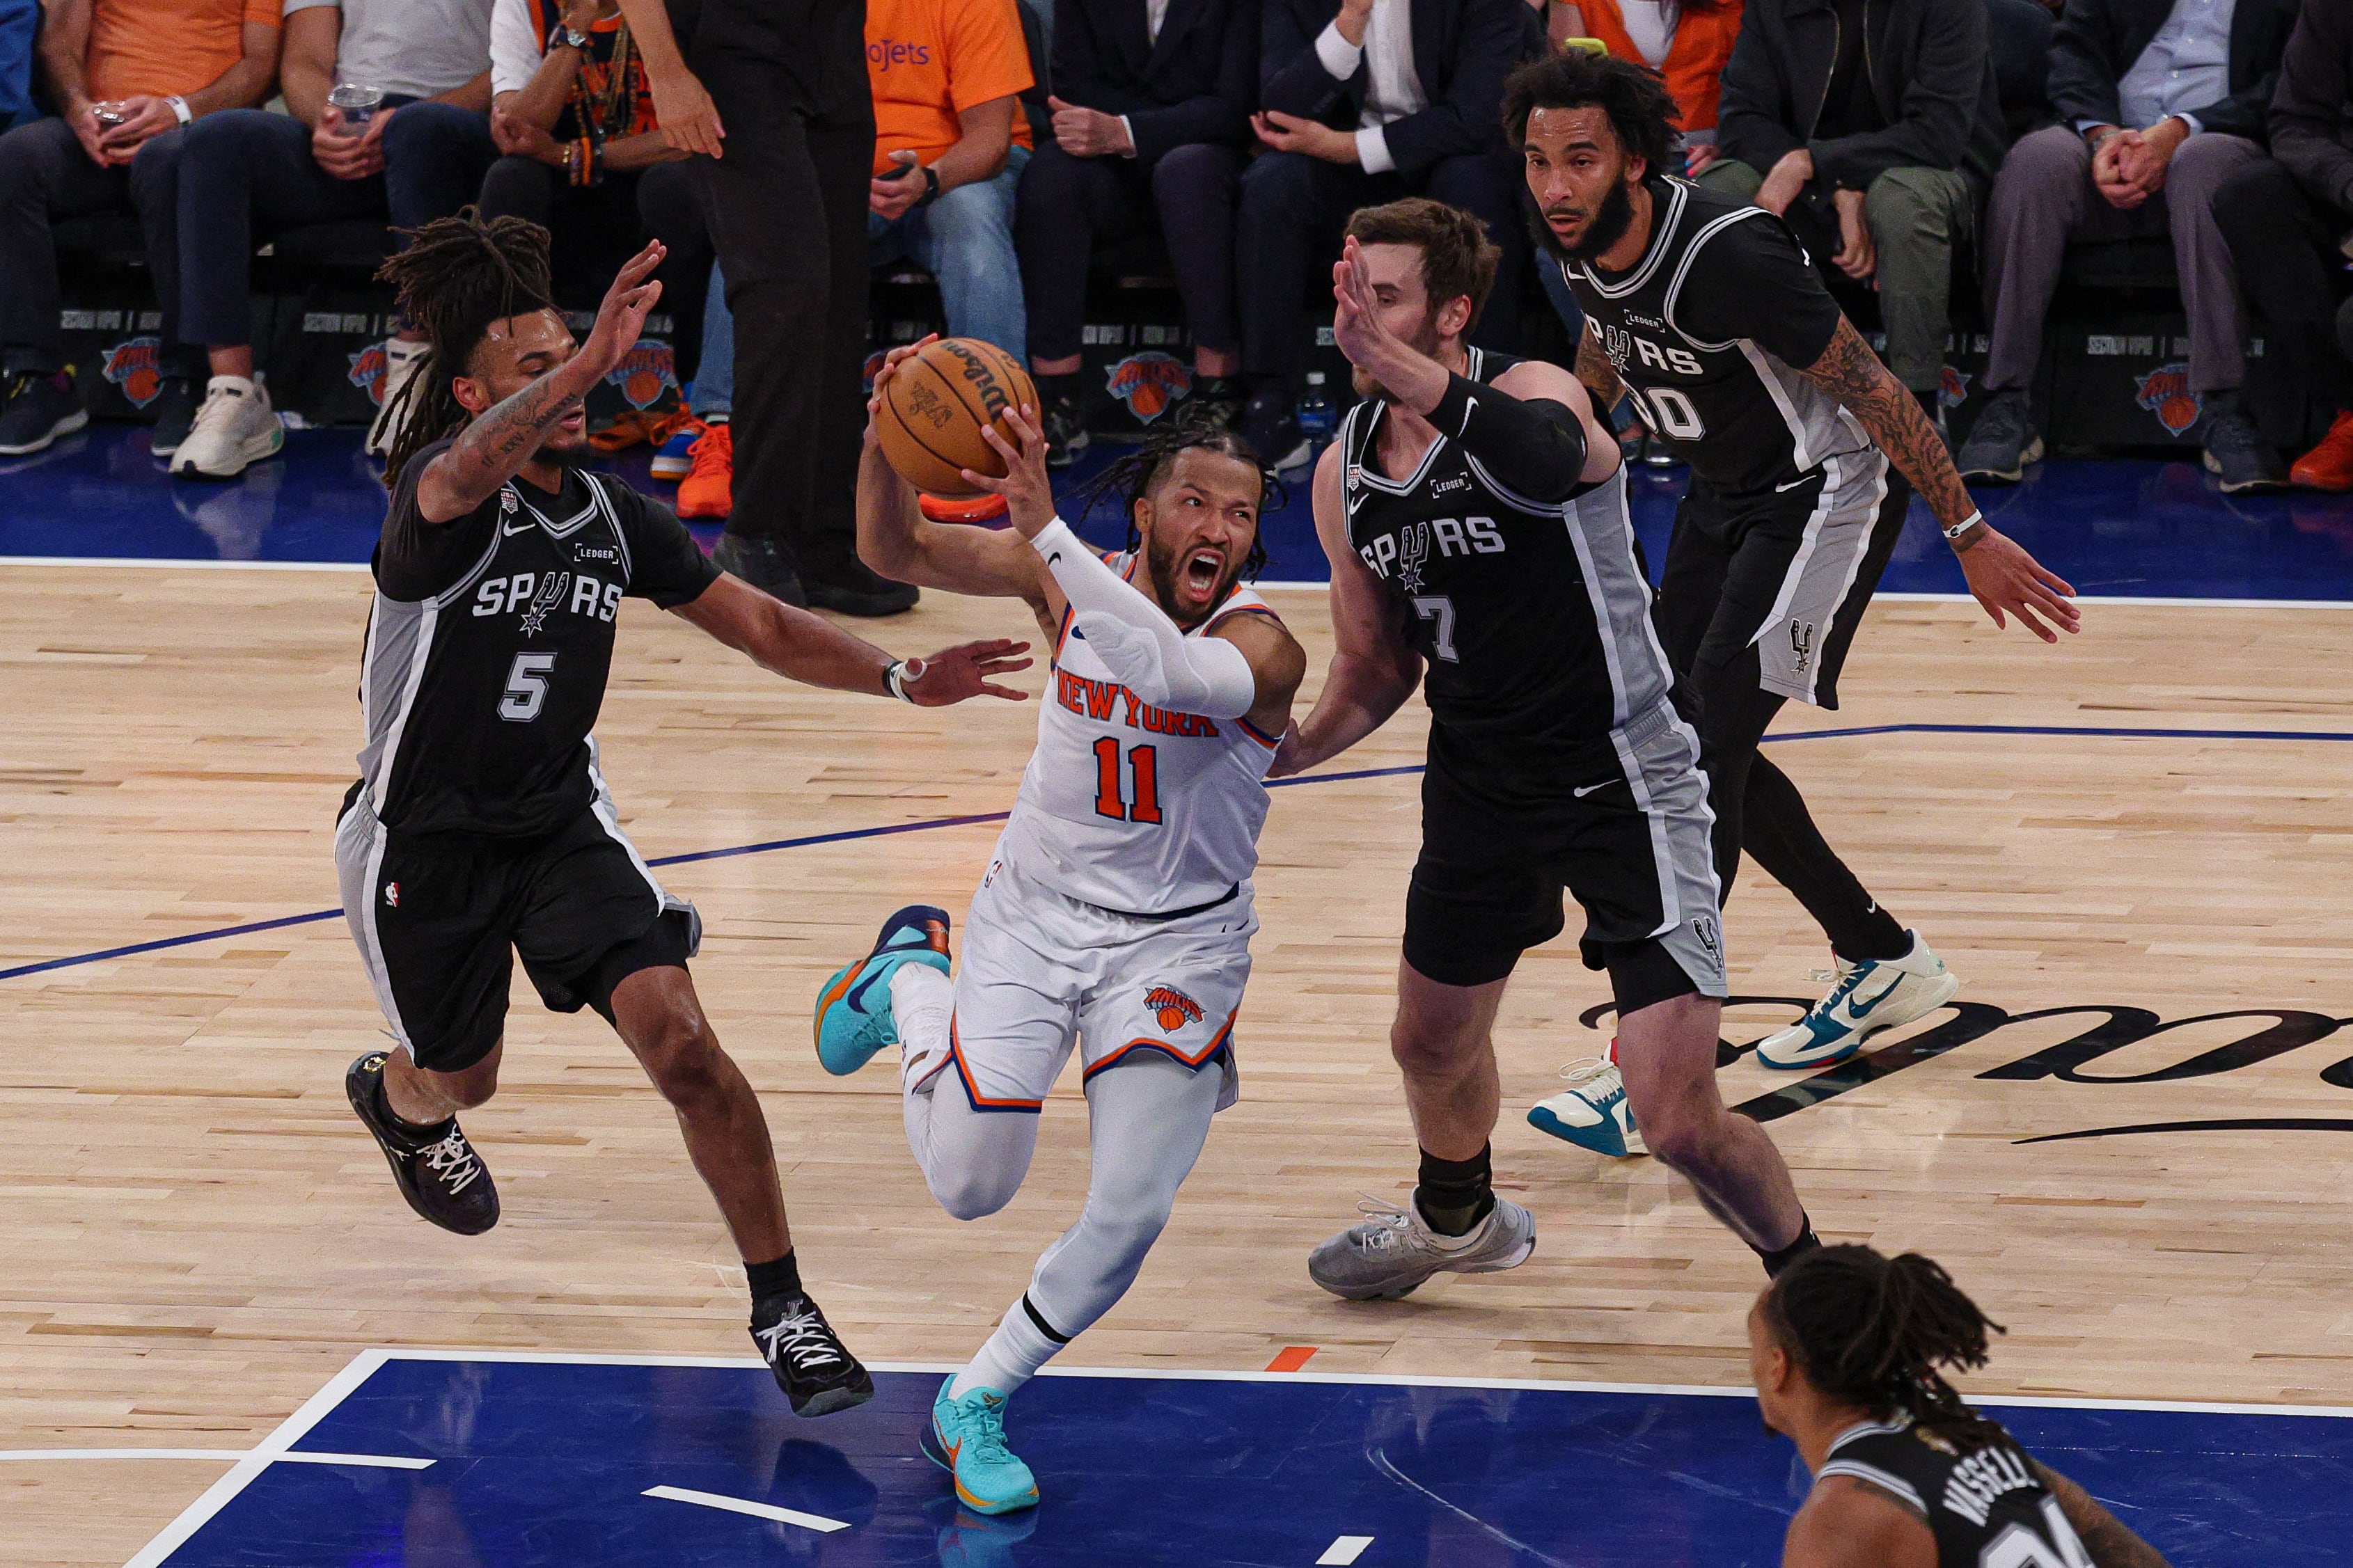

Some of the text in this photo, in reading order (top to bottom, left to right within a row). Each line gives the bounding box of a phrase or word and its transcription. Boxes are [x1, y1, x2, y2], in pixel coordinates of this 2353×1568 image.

[1629, 314, 1660, 328] LEDGER
[940, 340, 1010, 424] Wilson
[1435, 477, 1466, 493] LEDGER
[579, 547, 614, 560] LEDGER
[472, 571, 623, 638] SPURS
[1410, 595, 1460, 664] 7
[497, 651, 558, 722] 5
[1057, 666, 1119, 722] NEW
[1092, 736, 1163, 825] 11
